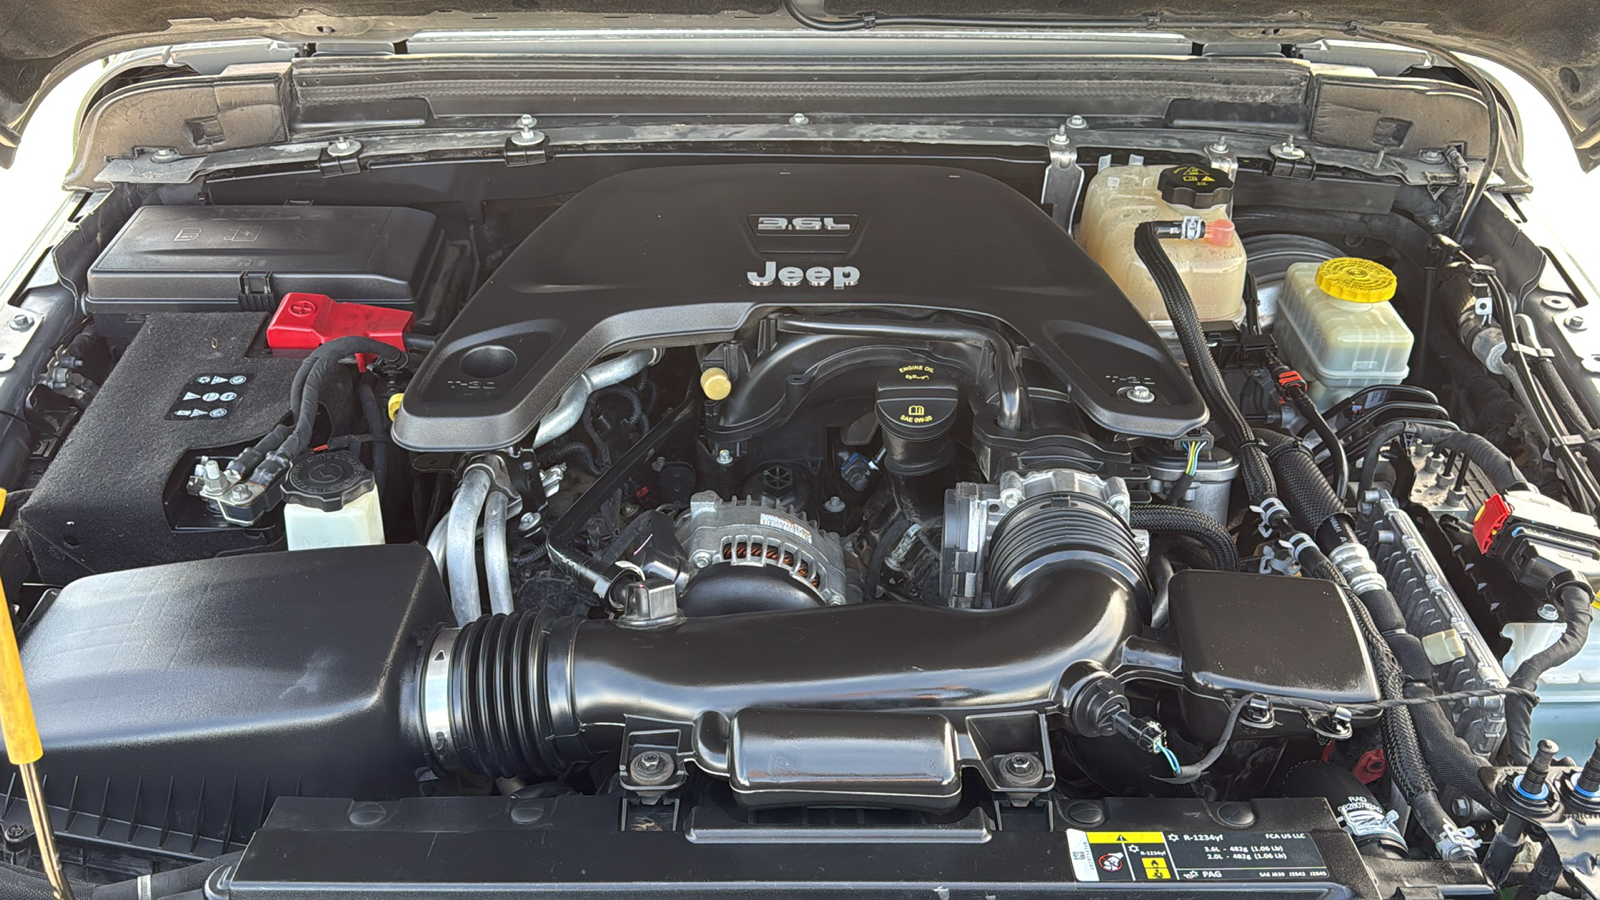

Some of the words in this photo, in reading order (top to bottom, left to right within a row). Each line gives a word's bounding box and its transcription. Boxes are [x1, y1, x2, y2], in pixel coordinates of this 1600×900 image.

[757, 217, 851, 231] 3.6L
[746, 261, 861, 290] Jeep
[898, 365, 924, 373] ENGINE
[914, 415, 932, 423] 0W-20
[1184, 834, 1224, 843] R-1234yf
